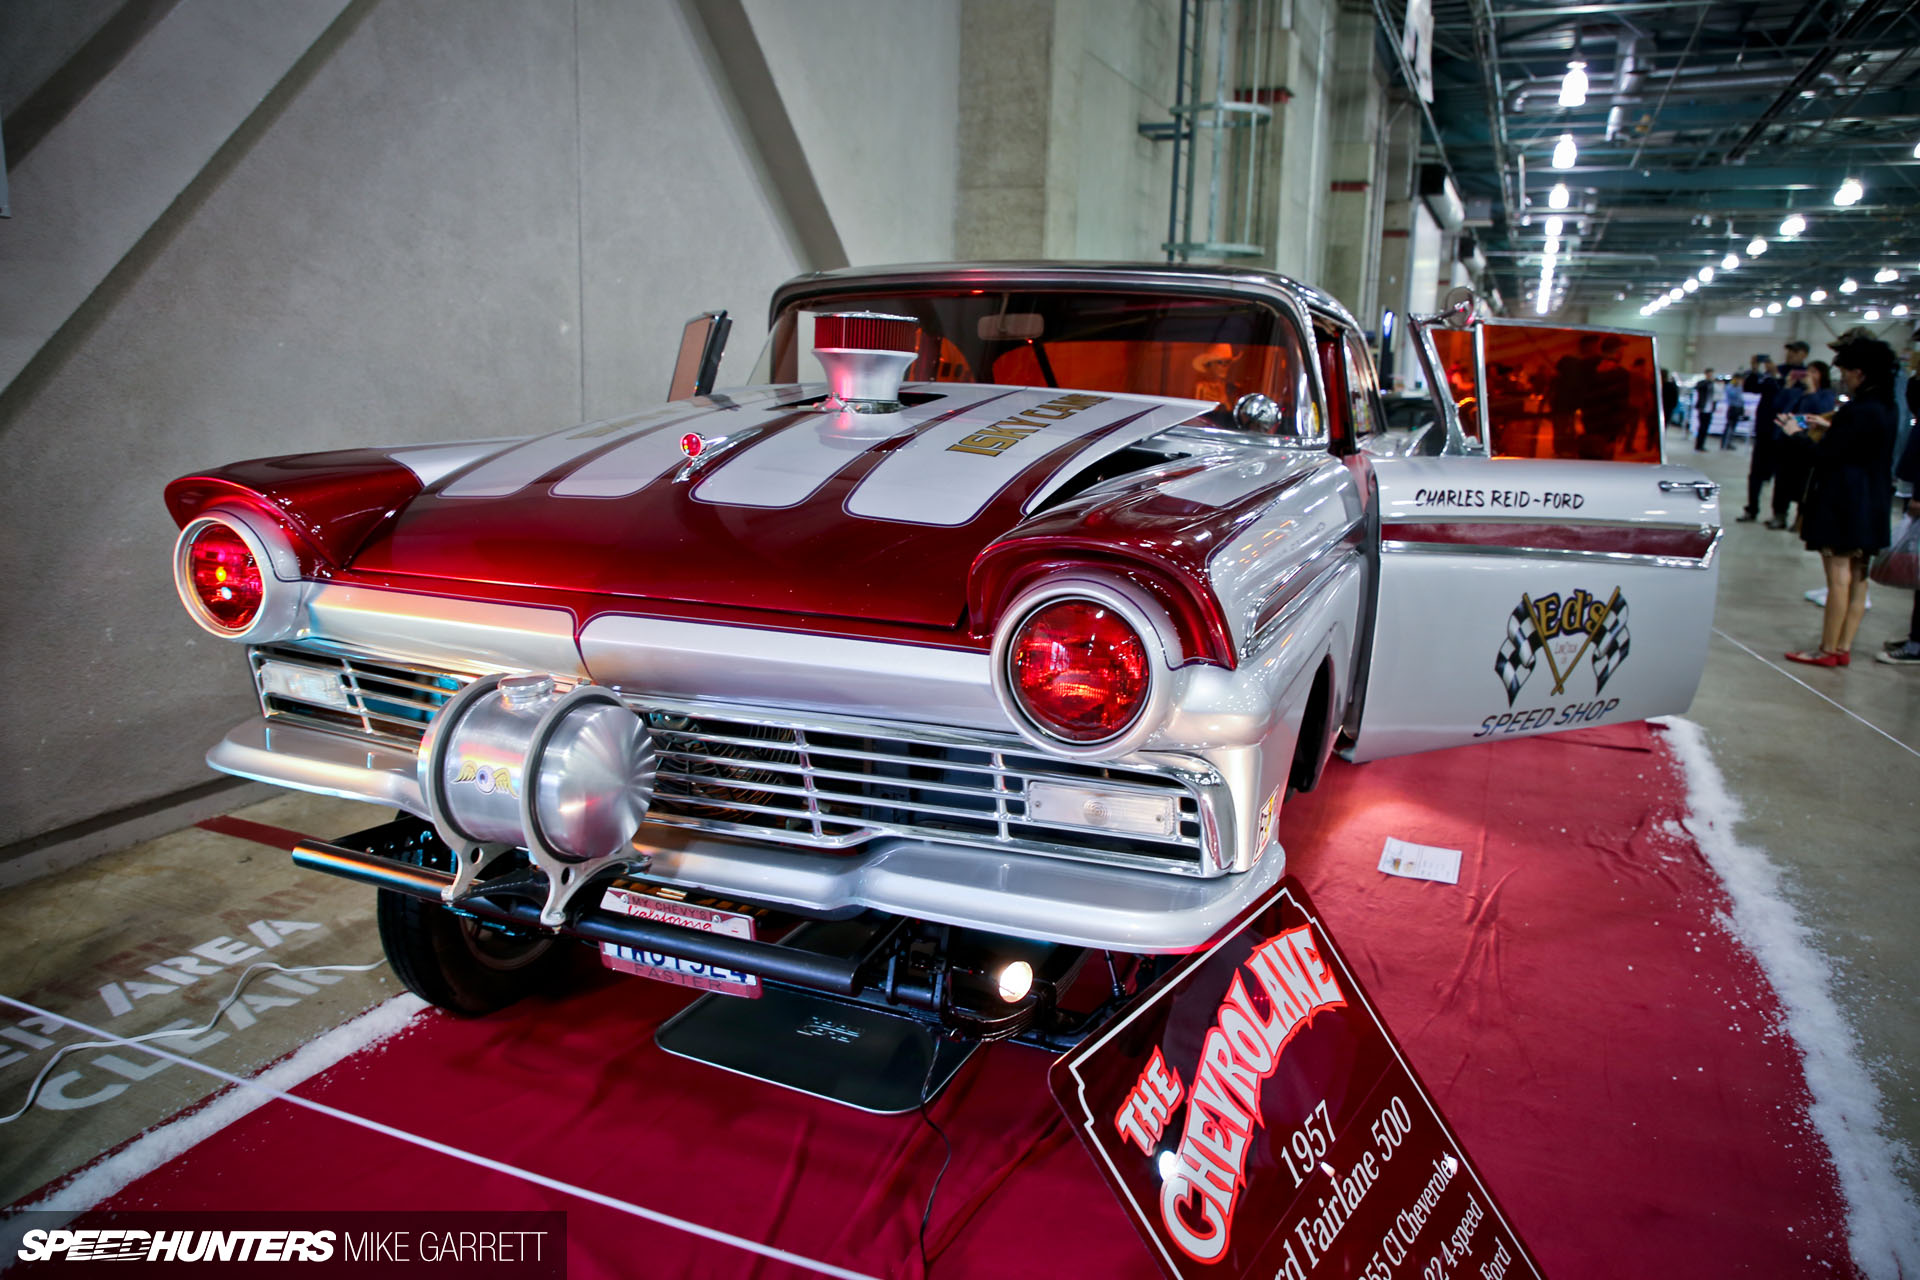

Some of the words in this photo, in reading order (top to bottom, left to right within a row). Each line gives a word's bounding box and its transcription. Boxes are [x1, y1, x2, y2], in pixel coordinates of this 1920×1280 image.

[945, 416, 1051, 457] ISKY
[1415, 489, 1485, 507] CHARLES
[1533, 588, 1606, 640] Ed's
[1473, 707, 1554, 738] SPEED
[1554, 698, 1620, 727] SHOP
[98, 919, 322, 1017] AREA
[634, 963, 722, 992] FASTER
[1115, 1046, 1185, 1157] THE
[1160, 923, 1348, 1265] CHEVROLANE
[1281, 1100, 1337, 1189] 1957
[1294, 1150, 1380, 1270] Fairlane
[1370, 1096, 1411, 1162] 500
[1358, 1251, 1391, 1280] 55
[1383, 1228, 1407, 1266] CI
[1441, 1192, 1484, 1268] 4-speed
[1480, 1236, 1511, 1280] Ford
